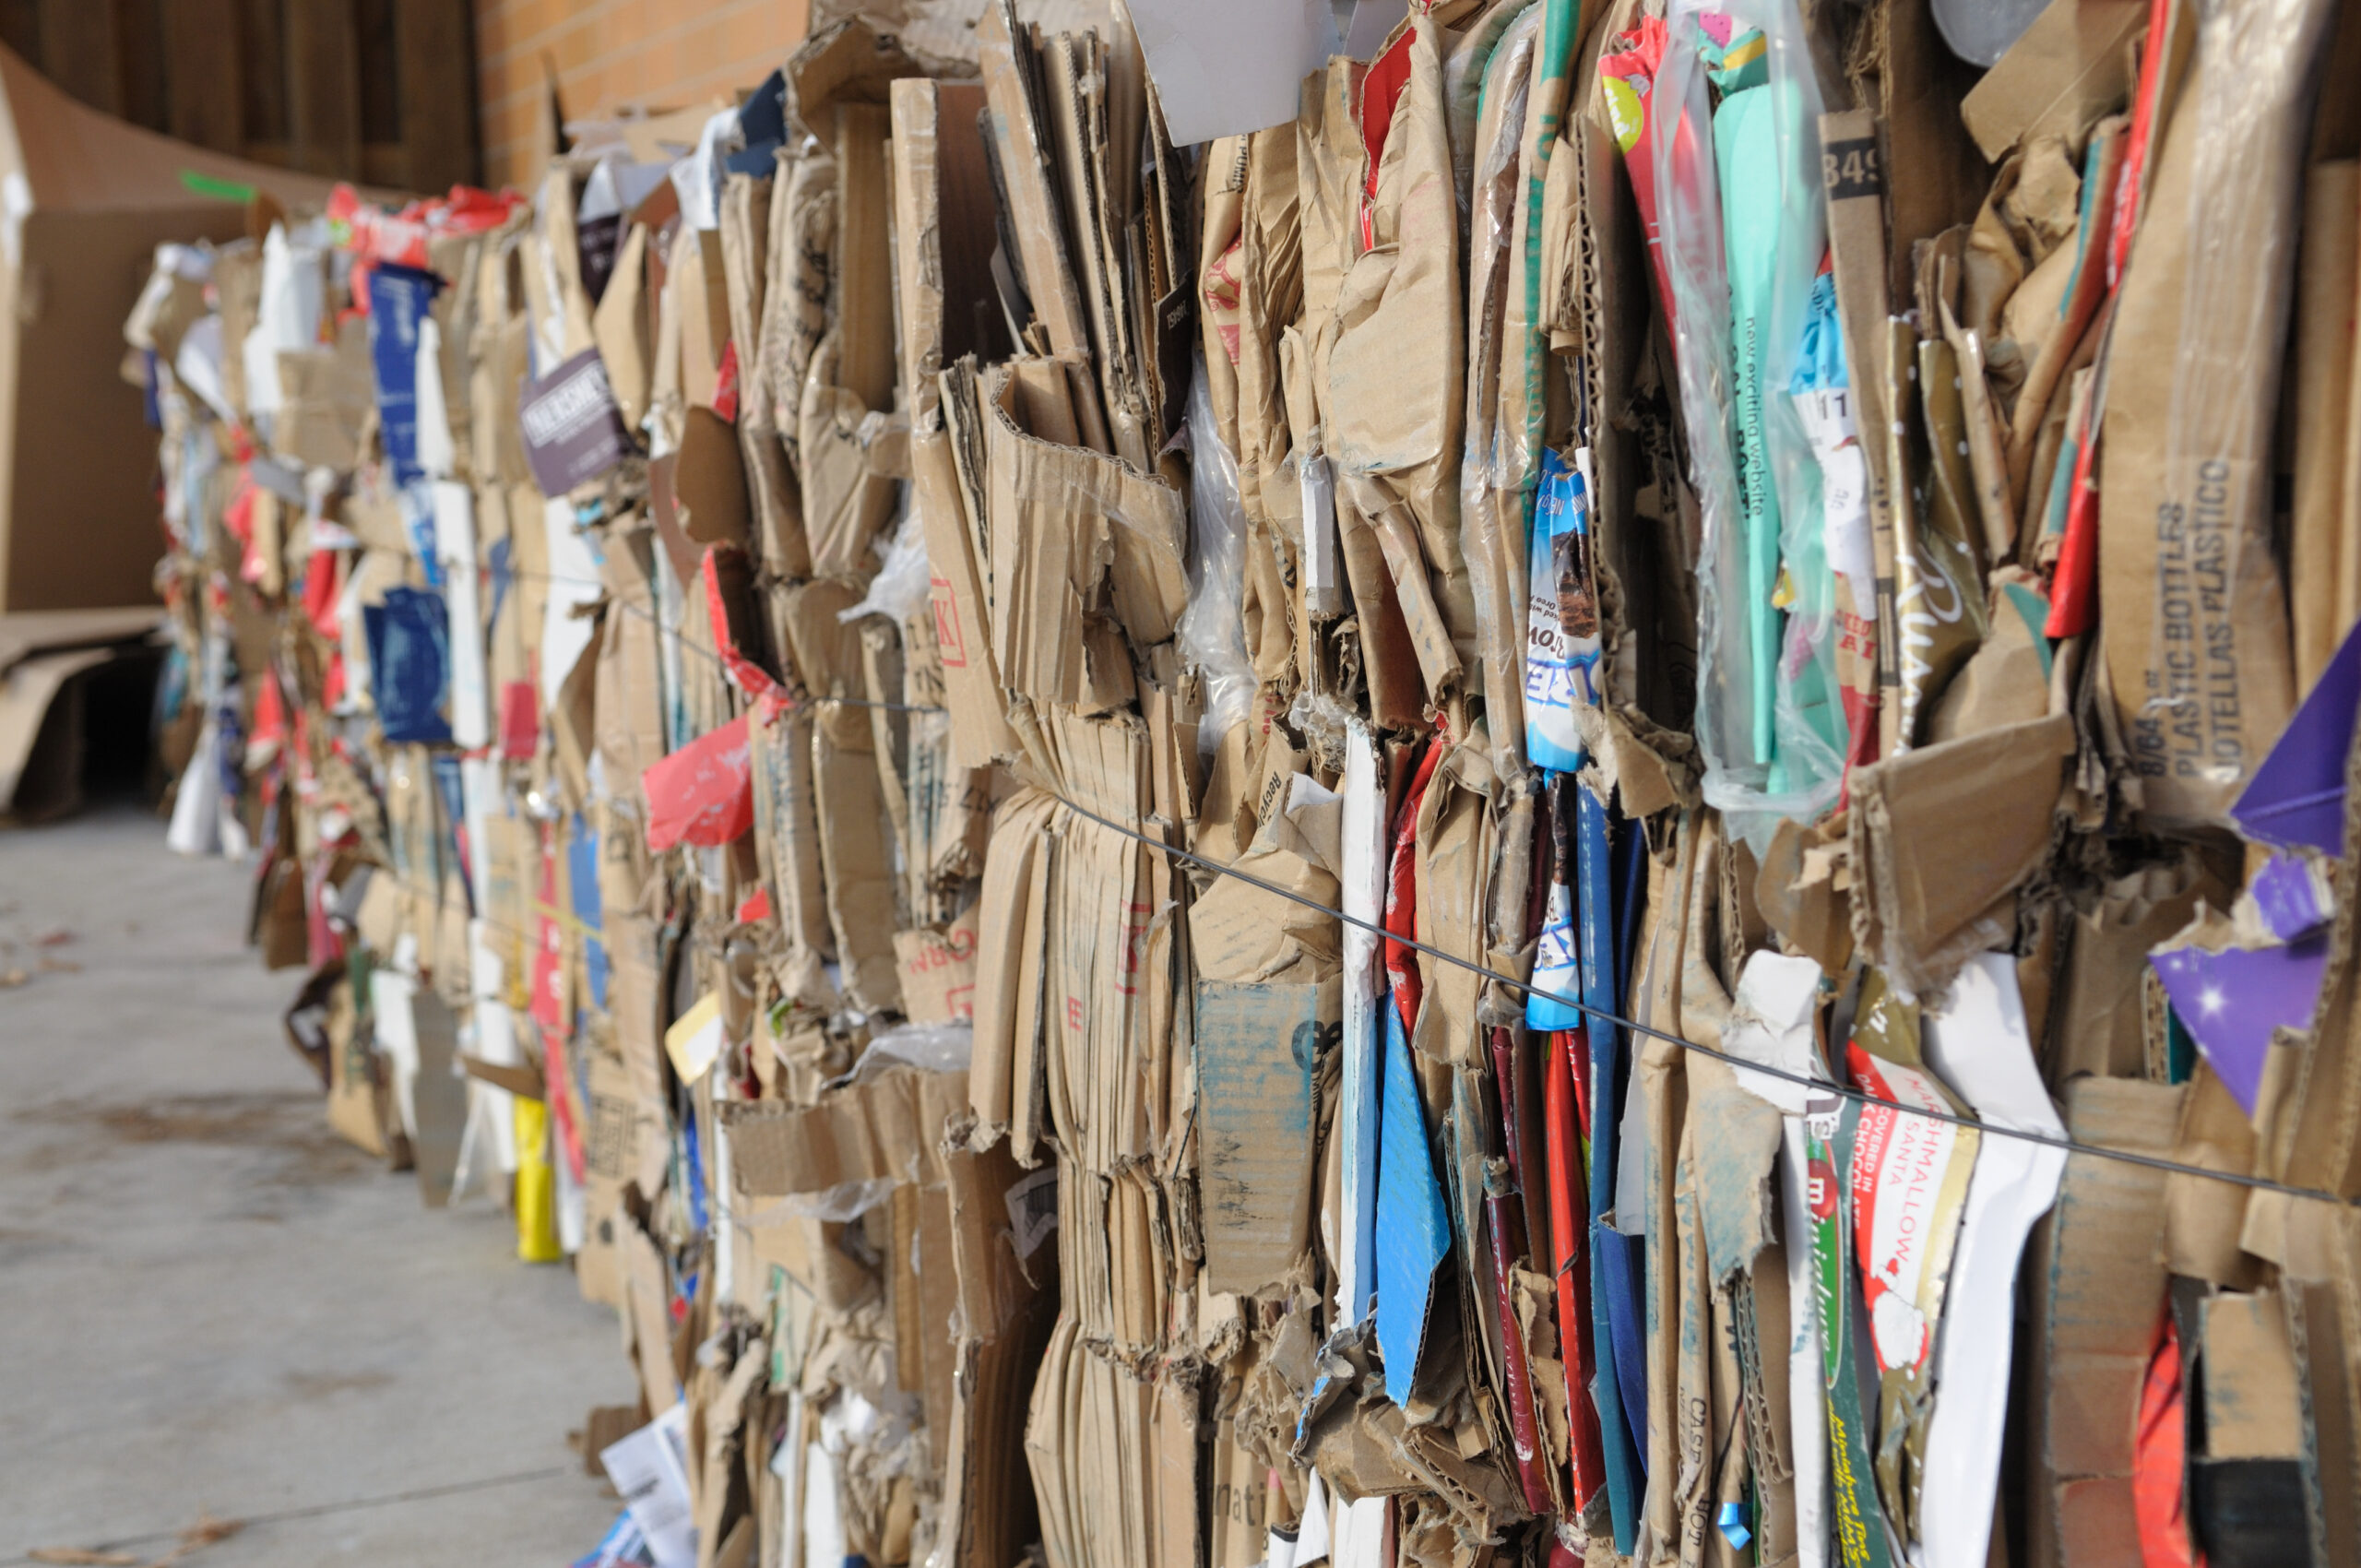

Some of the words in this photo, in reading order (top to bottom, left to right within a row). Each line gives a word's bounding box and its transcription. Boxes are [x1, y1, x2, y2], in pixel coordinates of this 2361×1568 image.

[1749, 440, 1767, 517] website
[2158, 502, 2195, 641] BOTTLES
[2194, 459, 2229, 614] PLASTICO
[2166, 651, 2204, 778] PLASTIC
[1862, 1177, 1874, 1193] IN
[1864, 1105, 1892, 1172] COVERED
[1889, 1120, 1920, 1186] SANTA
[1895, 1076, 1945, 1263] MARSHMALLOW
[1834, 1415, 1859, 1516] Miniature
